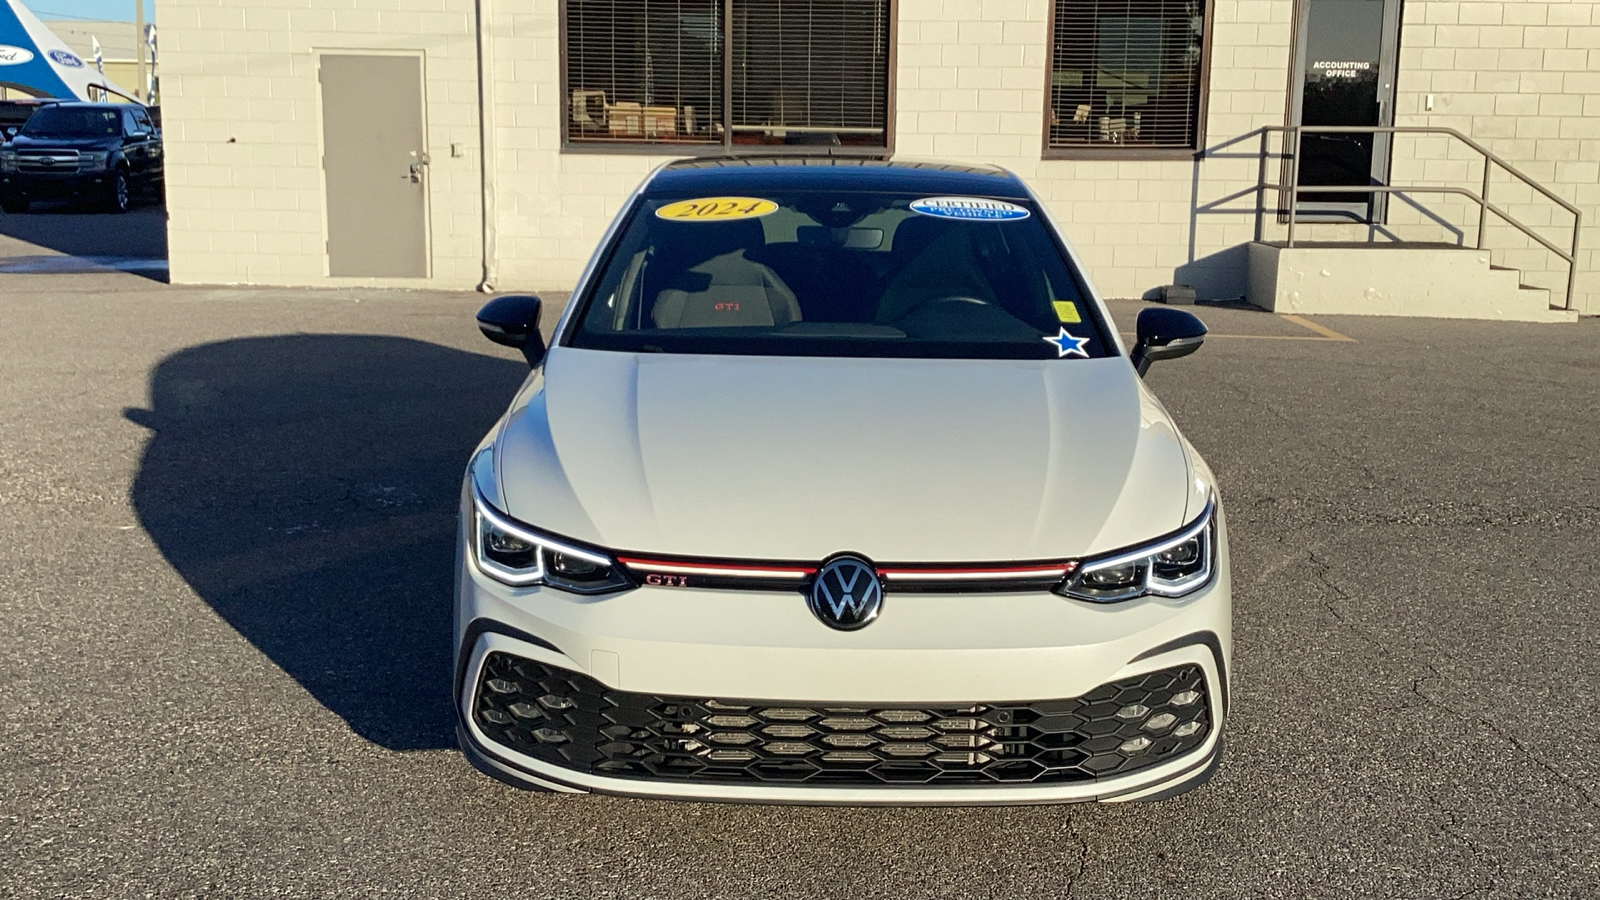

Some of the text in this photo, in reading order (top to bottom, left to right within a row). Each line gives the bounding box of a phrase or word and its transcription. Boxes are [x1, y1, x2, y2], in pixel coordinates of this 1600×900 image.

[53, 51, 79, 66] Ford
[1313, 61, 1370, 70] ACCOUNTING
[1325, 69, 1357, 78] OFFICE
[674, 202, 762, 218] 2024
[923, 199, 1015, 211] CERTIFIED
[714, 302, 740, 311] GTI
[646, 573, 688, 587] GTI
